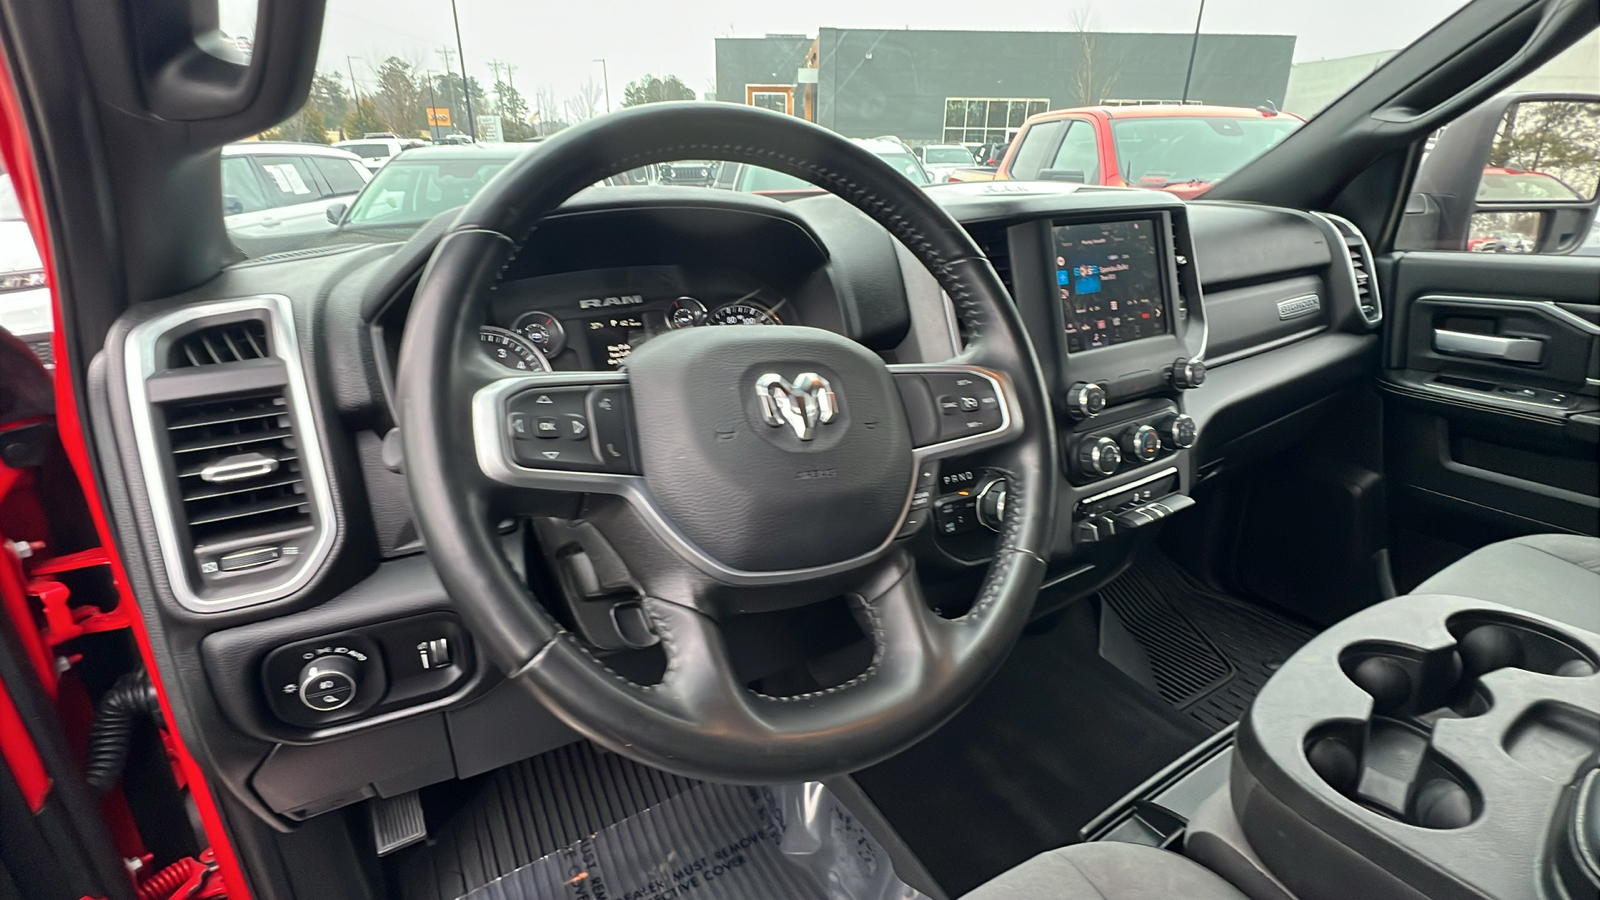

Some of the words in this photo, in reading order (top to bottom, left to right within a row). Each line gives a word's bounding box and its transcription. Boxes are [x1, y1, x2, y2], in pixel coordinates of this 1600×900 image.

[579, 295, 643, 309] RAM
[497, 348, 507, 358] 3
[516, 361, 526, 370] 4
[539, 422, 557, 431] OK
[673, 857, 708, 881] MUST
[714, 830, 766, 860] REMOVE
[703, 855, 746, 882] COVER
